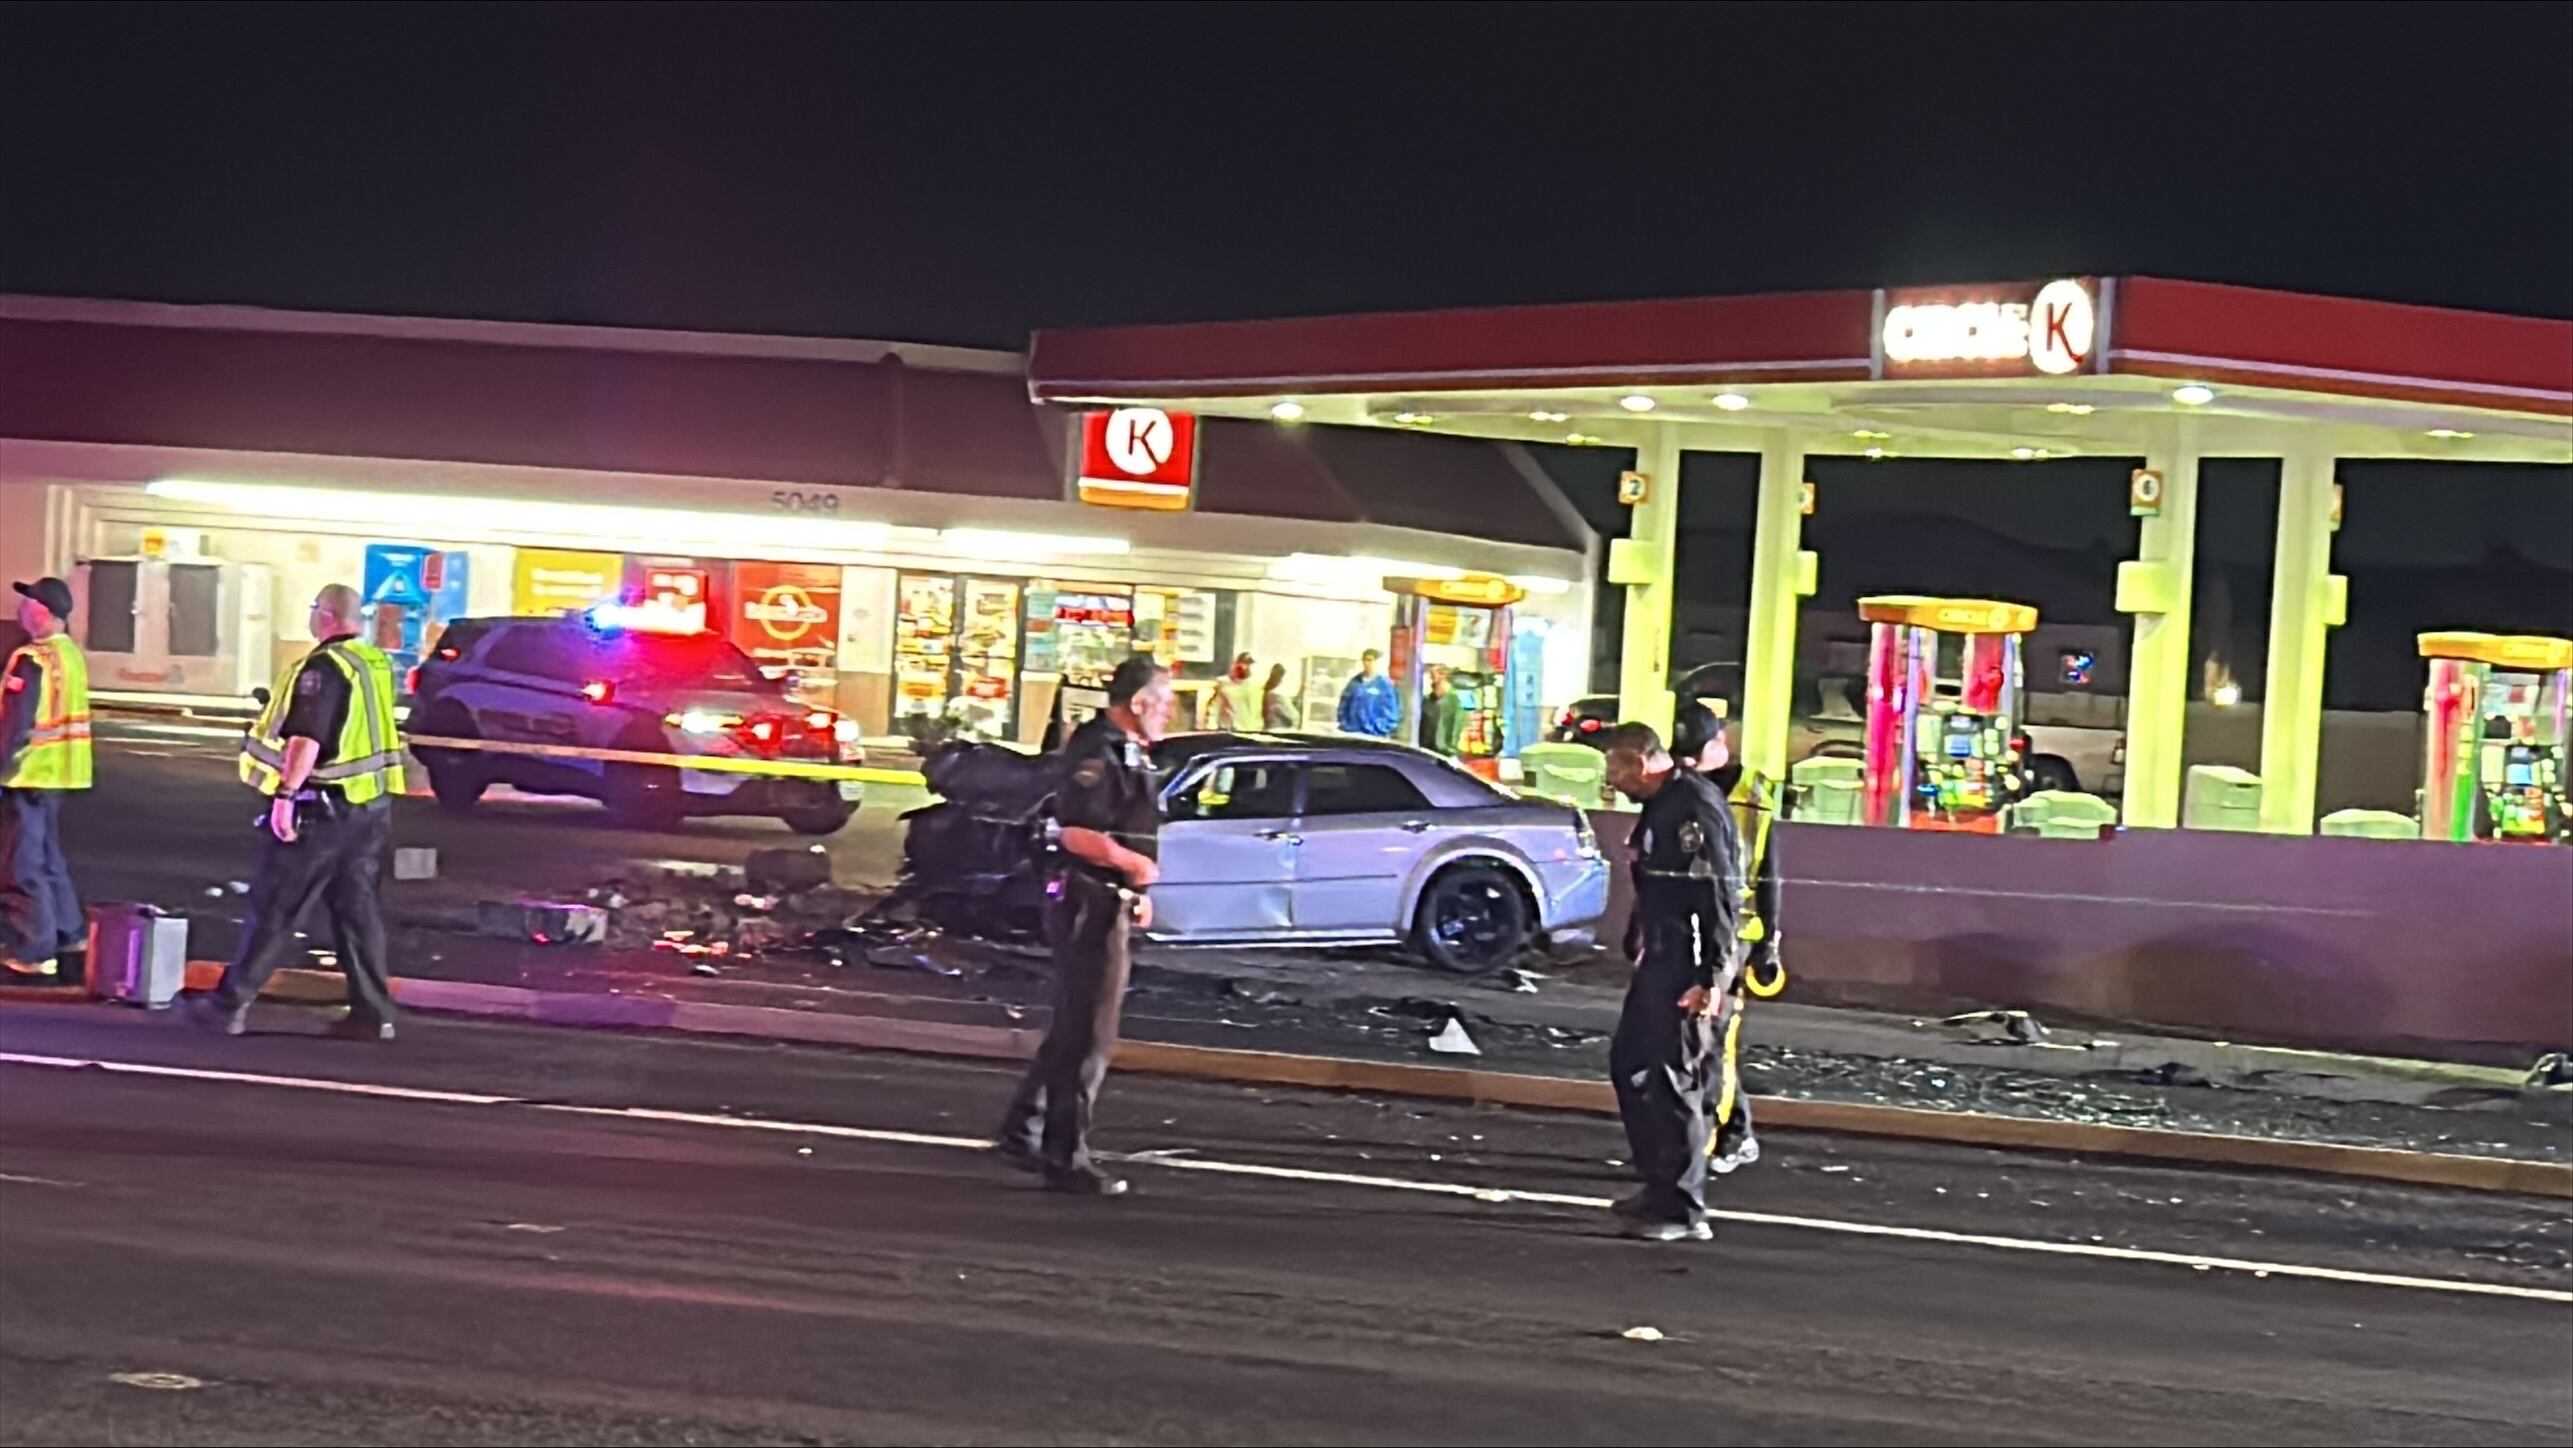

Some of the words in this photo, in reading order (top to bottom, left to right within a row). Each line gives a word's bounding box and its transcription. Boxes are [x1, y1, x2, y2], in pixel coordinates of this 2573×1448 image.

[2046, 302, 2083, 363] K
[1128, 419, 1161, 470] K
[771, 491, 840, 513] 5049
